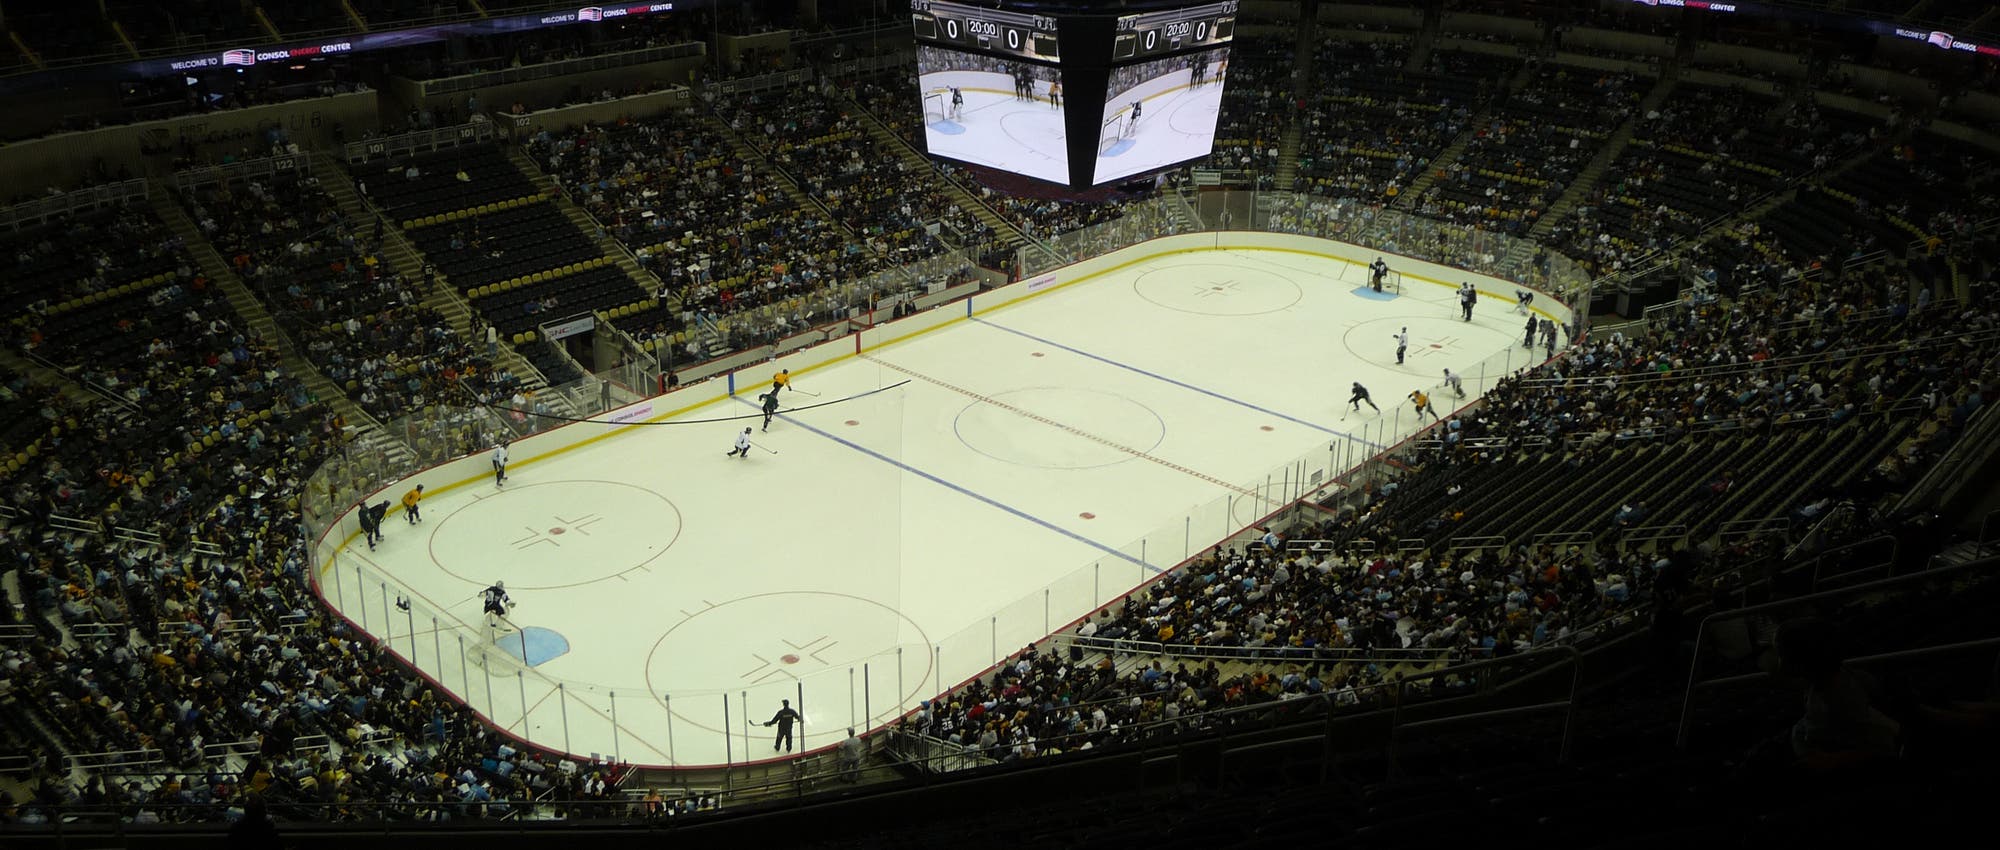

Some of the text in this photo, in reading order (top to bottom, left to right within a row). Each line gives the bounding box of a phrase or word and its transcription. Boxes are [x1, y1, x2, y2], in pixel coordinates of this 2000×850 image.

[603, 8, 628, 18] CONSOL
[650, 3, 673, 12] CENTER
[1710, 3, 1736, 12] CENTER
[541, 15, 567, 24] WELCOME
[947, 20, 958, 39] 0
[969, 21, 996, 35] 20:00
[1166, 22, 1190, 37] 20:00
[1196, 21, 1206, 41] 0
[1895, 29, 1919, 39] WELCOME
[1008, 29, 1019, 49] 0
[1146, 31, 1156, 50] 0
[1952, 40, 1977, 52] CONSOL
[257, 42, 351, 62] CONSOL ENERGY CENTER
[171, 57, 218, 70] WELCOME TO
[369, 143, 384, 153] 101
[275, 158, 295, 170] 122
